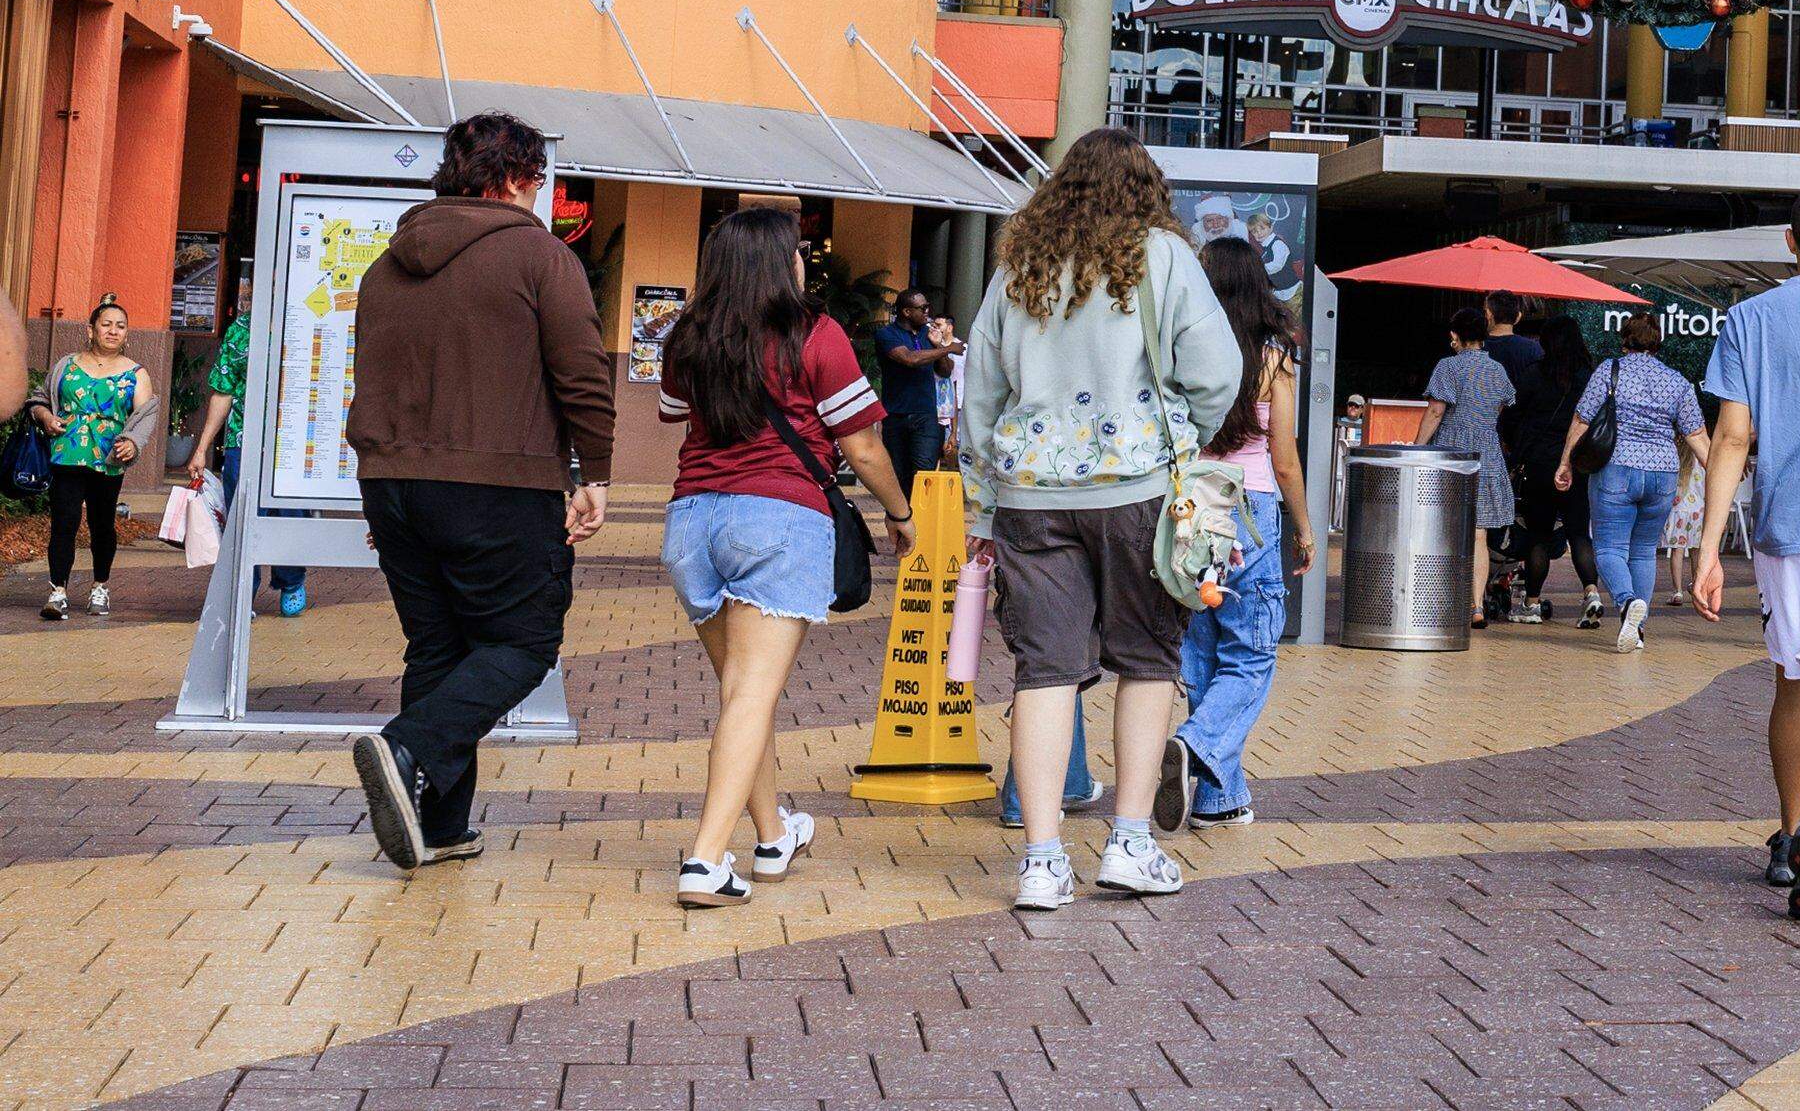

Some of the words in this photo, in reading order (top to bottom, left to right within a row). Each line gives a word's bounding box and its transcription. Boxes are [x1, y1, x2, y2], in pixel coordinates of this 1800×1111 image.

[903, 578, 932, 593] CAUTION
[900, 598, 931, 614] CUIDADO
[901, 629, 925, 645] WET
[892, 648, 928, 665] FLOOR
[894, 679, 920, 696] PISO
[944, 681, 965, 696] PISO
[882, 698, 928, 716] MOJADO
[938, 699, 972, 716] MOJADO
